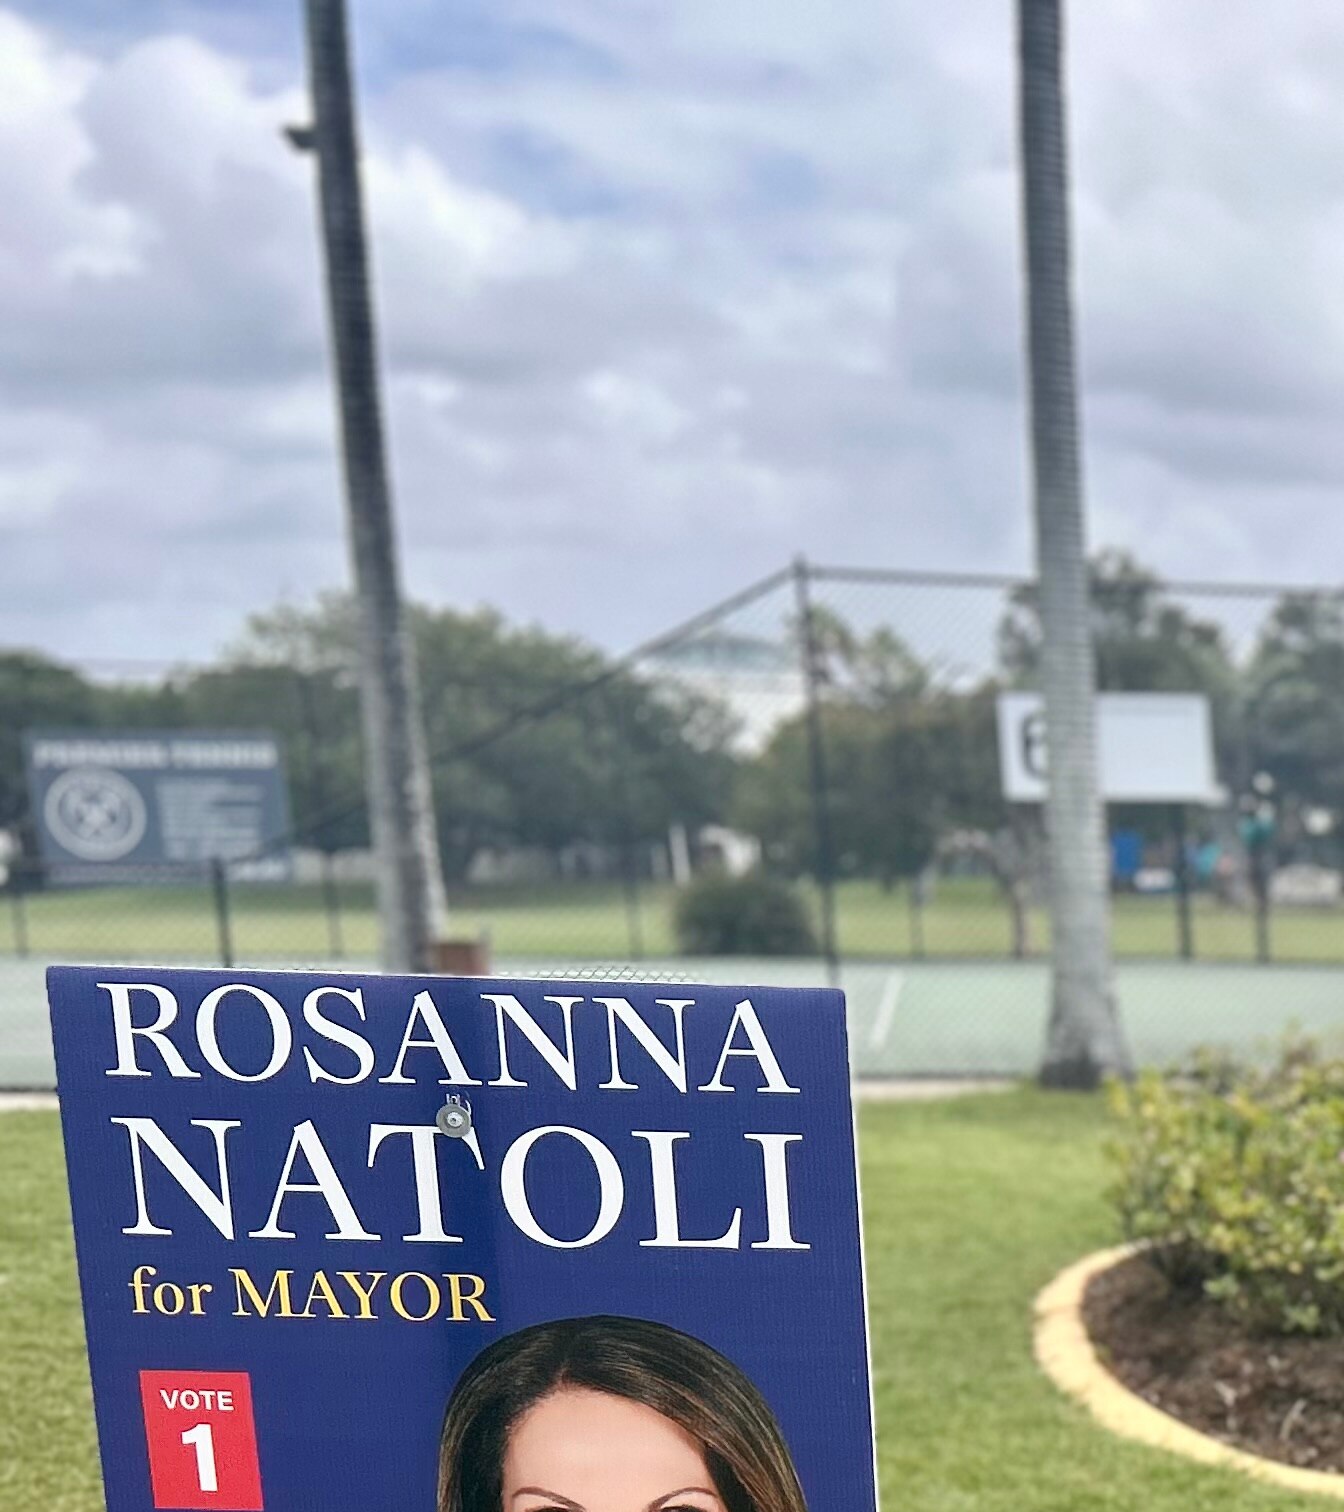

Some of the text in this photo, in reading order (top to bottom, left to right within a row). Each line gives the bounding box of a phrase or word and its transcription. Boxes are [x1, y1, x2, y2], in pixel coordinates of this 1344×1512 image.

[97, 982, 801, 1094] ROSANNA
[111, 1117, 811, 1250] NATOLI
[128, 1265, 496, 1322] for MAYOR
[160, 1389, 235, 1412] VOTE
[181, 1422, 218, 1493] 1
